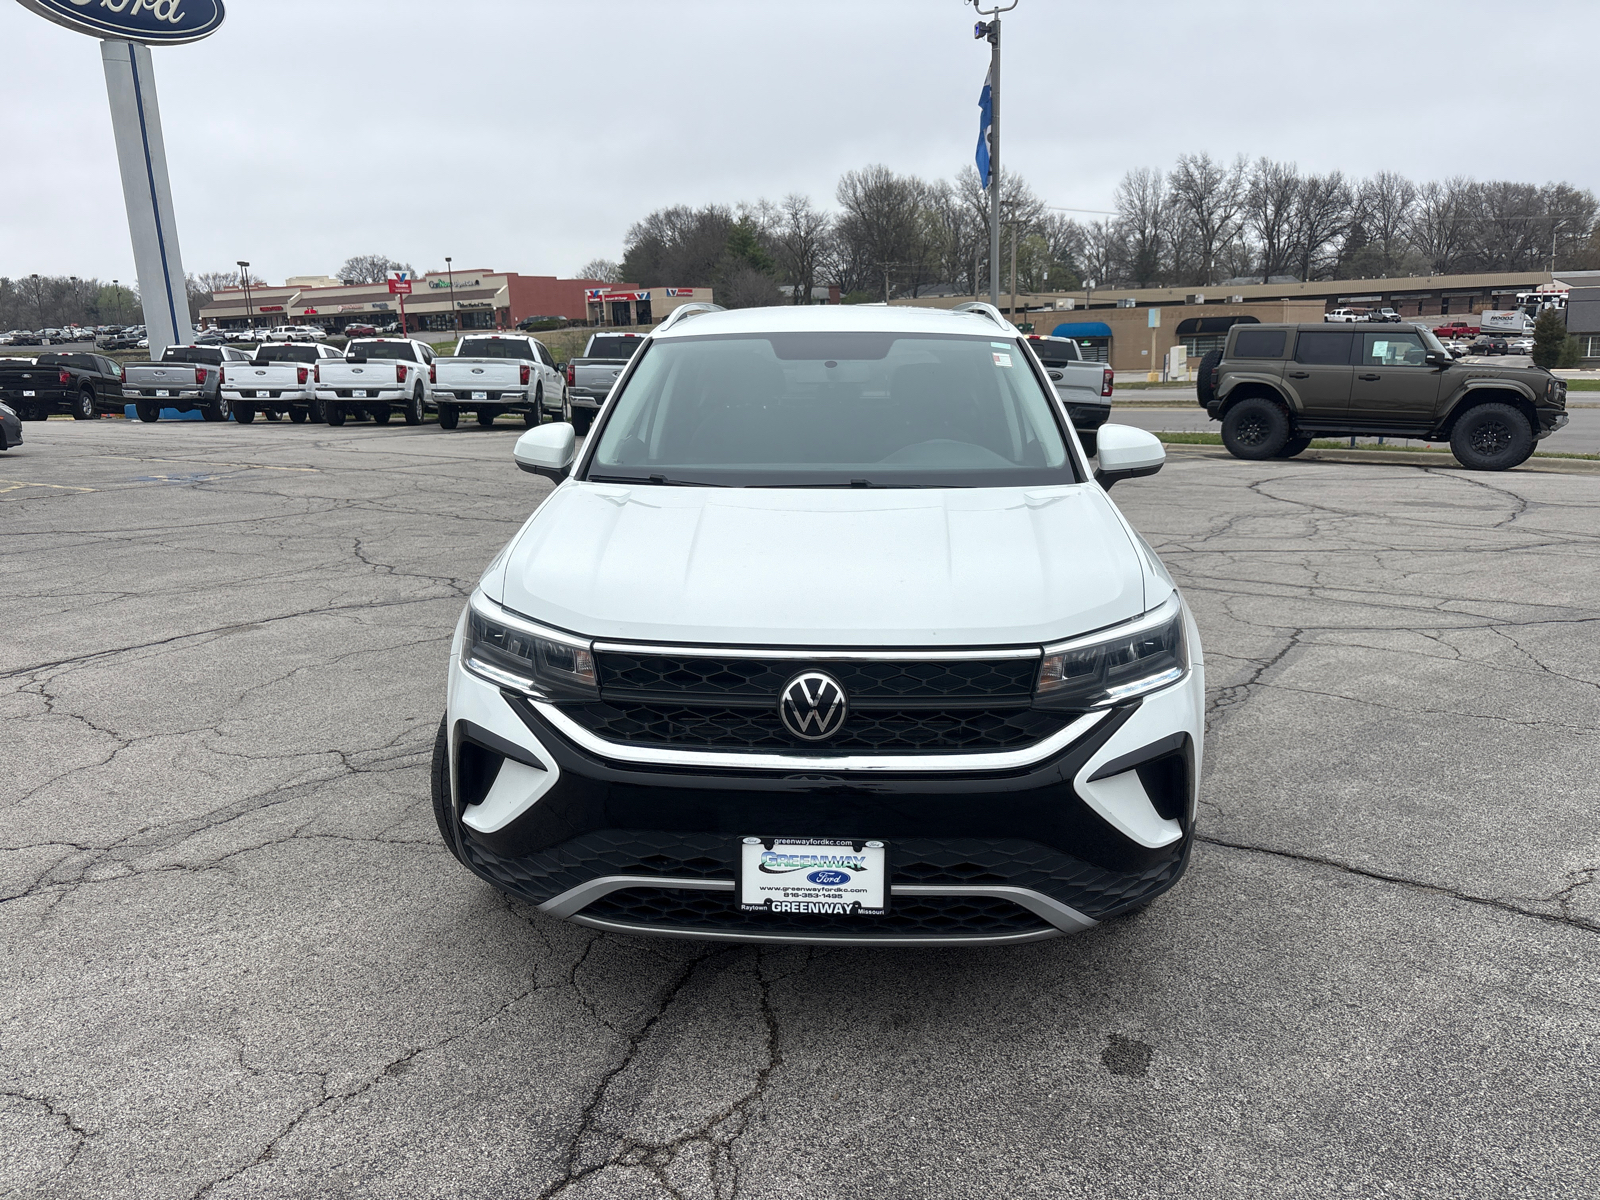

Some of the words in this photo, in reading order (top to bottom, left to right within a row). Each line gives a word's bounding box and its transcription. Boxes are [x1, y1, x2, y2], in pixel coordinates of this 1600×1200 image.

[774, 838, 853, 847] greenwayfordkc.com
[761, 851, 866, 869] GREENWAY
[816, 872, 842, 884] Ford
[759, 886, 868, 894] www.greenwayfordkc.com
[741, 904, 768, 912] Raytown
[771, 901, 854, 915] GREENWAY
[858, 908, 885, 916] Missouri
